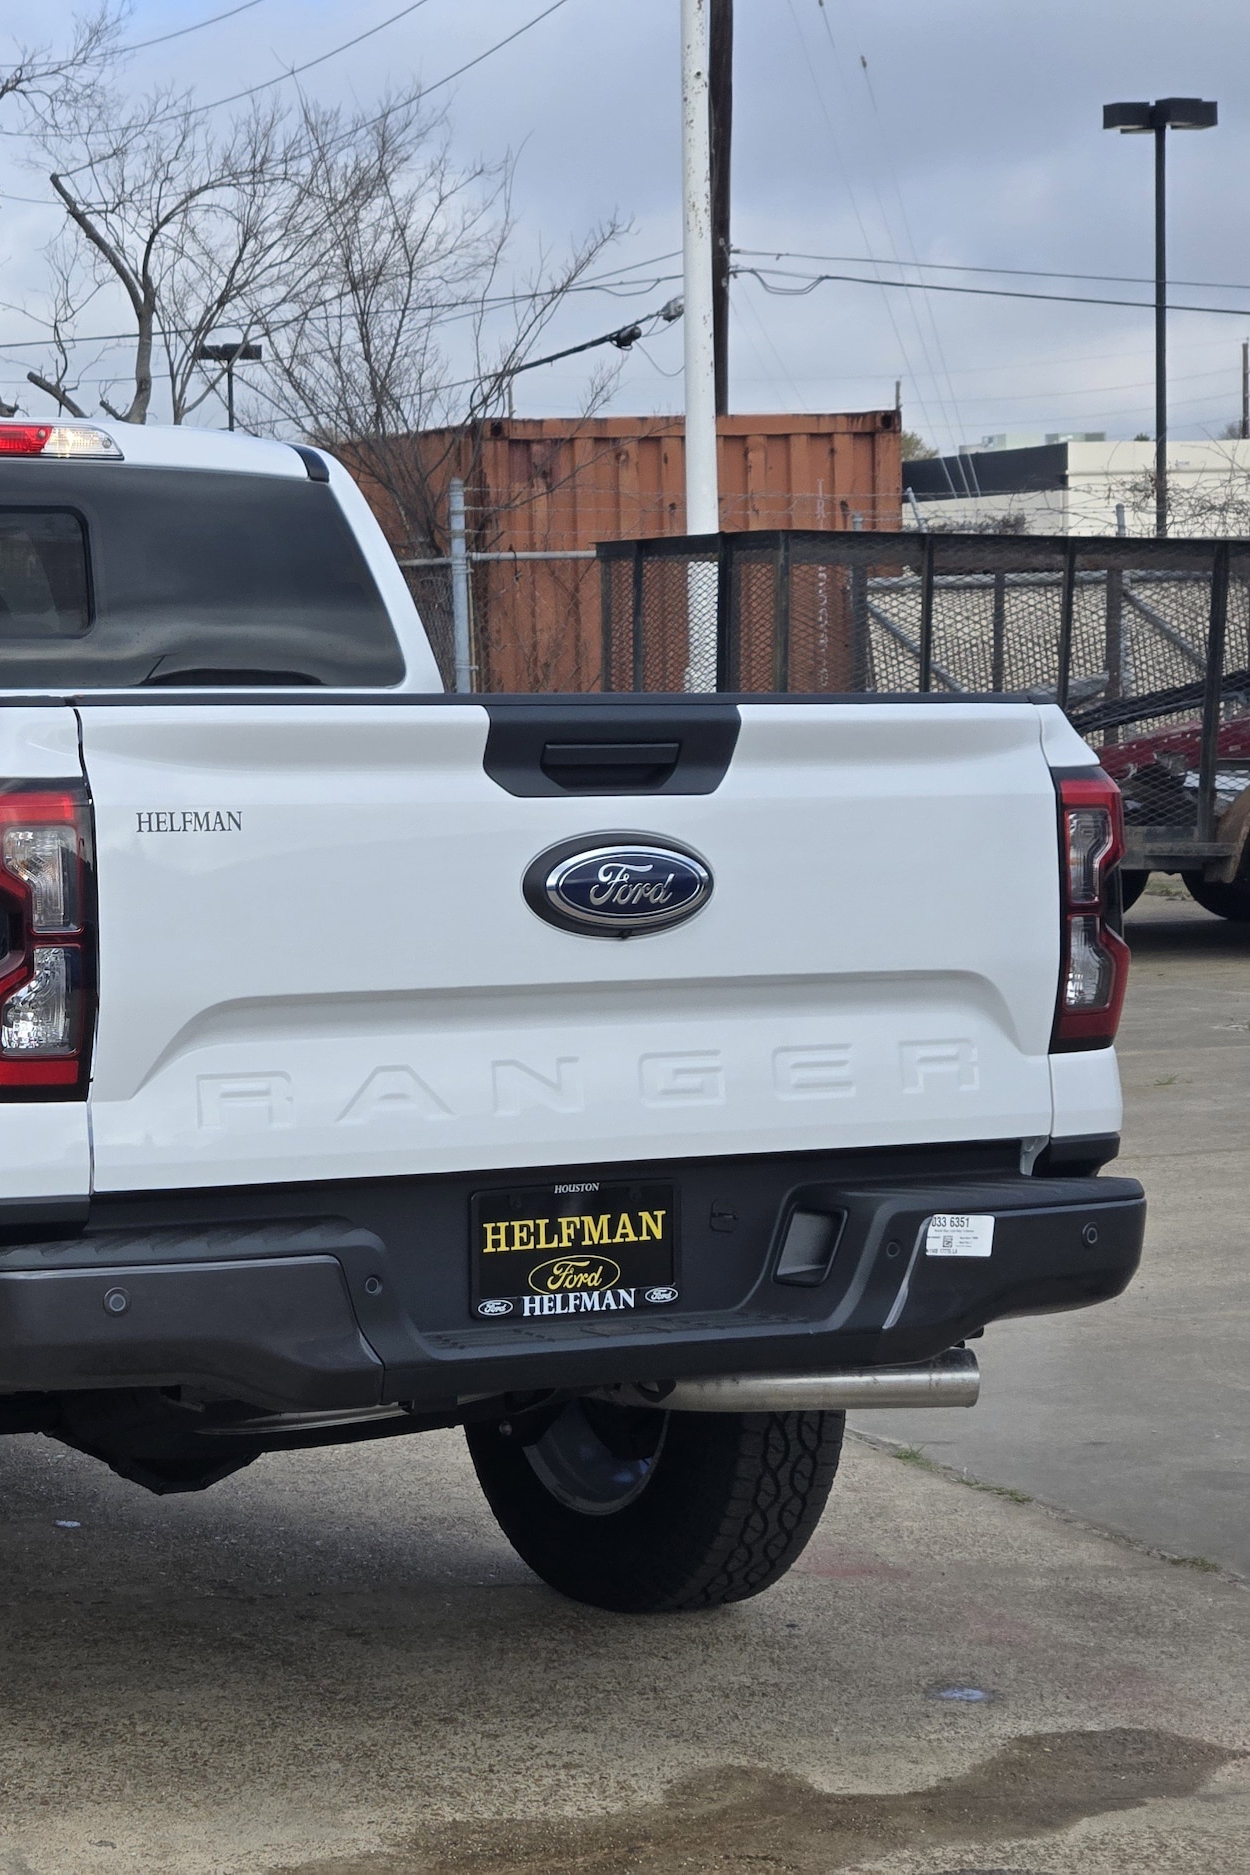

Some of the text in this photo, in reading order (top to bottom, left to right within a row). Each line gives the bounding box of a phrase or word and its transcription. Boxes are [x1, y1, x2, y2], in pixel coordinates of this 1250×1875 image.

[135, 811, 243, 833] HELFMAN
[589, 862, 675, 906] Ford
[196, 1036, 981, 1131] RANGER
[554, 1183, 600, 1194] HOUSTON
[482, 1210, 666, 1253] HELFMAN
[949, 1217, 970, 1228] 6351
[546, 1260, 604, 1290] Ford
[522, 1288, 636, 1317] HELFMAN
